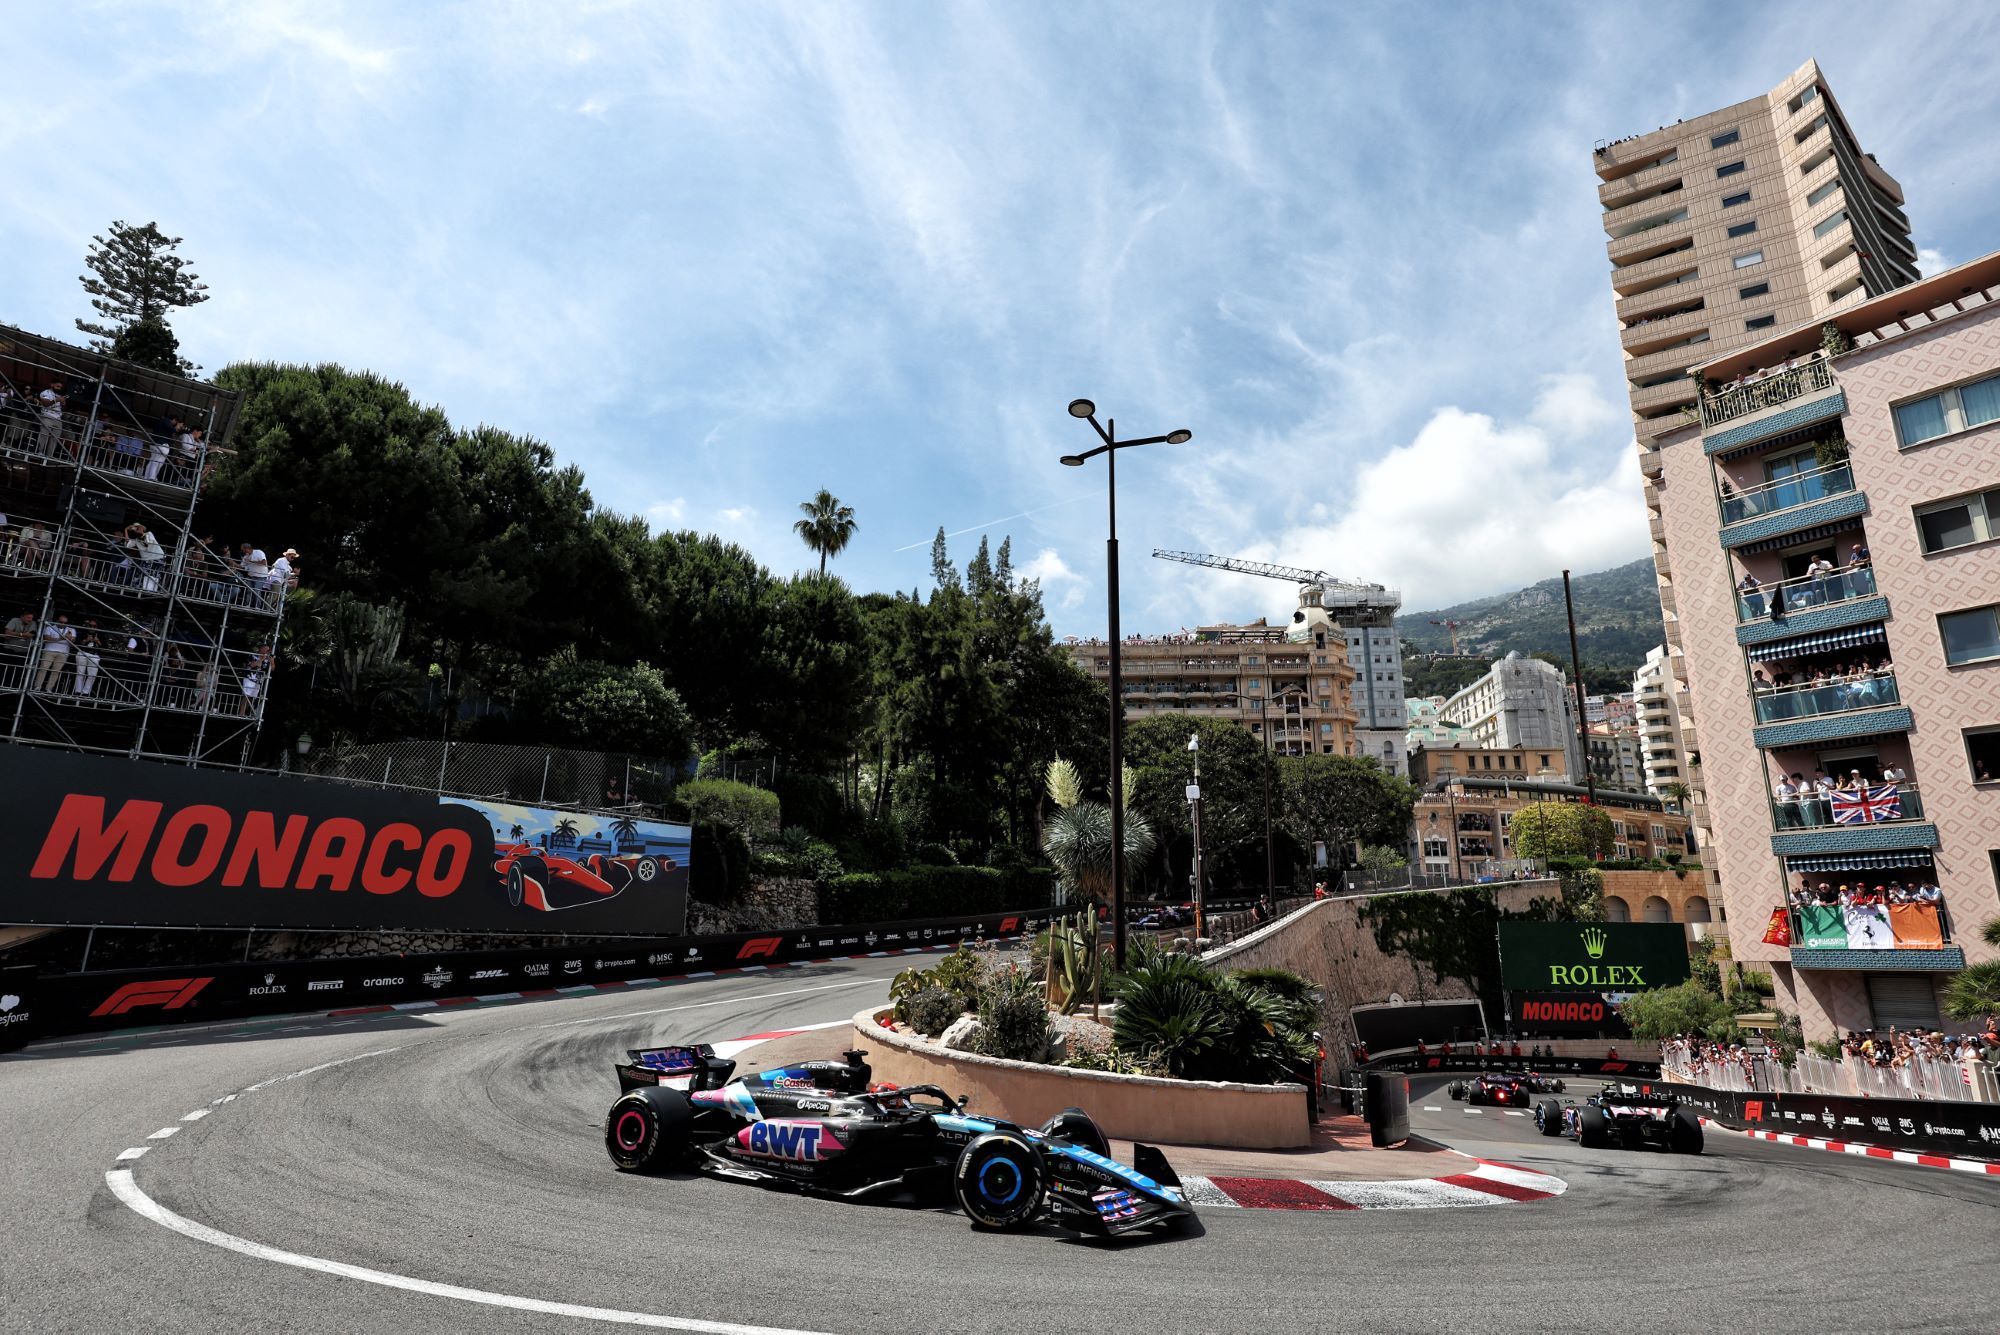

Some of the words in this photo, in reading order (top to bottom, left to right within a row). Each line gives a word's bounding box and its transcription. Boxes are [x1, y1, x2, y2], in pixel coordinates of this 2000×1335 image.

[30, 793, 472, 898] MONACO
[604, 958, 636, 968] crypto.com
[656, 953, 673, 963] MSC
[524, 963, 550, 974] QATAR
[564, 960, 582, 969] aws
[1549, 965, 1647, 986] ROLEX
[307, 980, 344, 991] PIRELLI
[363, 976, 405, 987] aramco
[249, 985, 287, 996] ROLEX
[1522, 1002, 1604, 1021] MONACO
[784, 1078, 816, 1089] Castrol
[1613, 1092, 1668, 1101] ALPINE
[805, 1101, 829, 1111] ApeCoin
[1871, 1117, 1890, 1127] QATAR
[1898, 1117, 1914, 1128] aws
[936, 1131, 976, 1142] ALPIN
[1932, 1125, 1966, 1137] crypto.com
[750, 1120, 822, 1161] BWT
[1077, 1163, 1113, 1184] INFINOX
[1063, 1185, 1088, 1197] Microsoft
